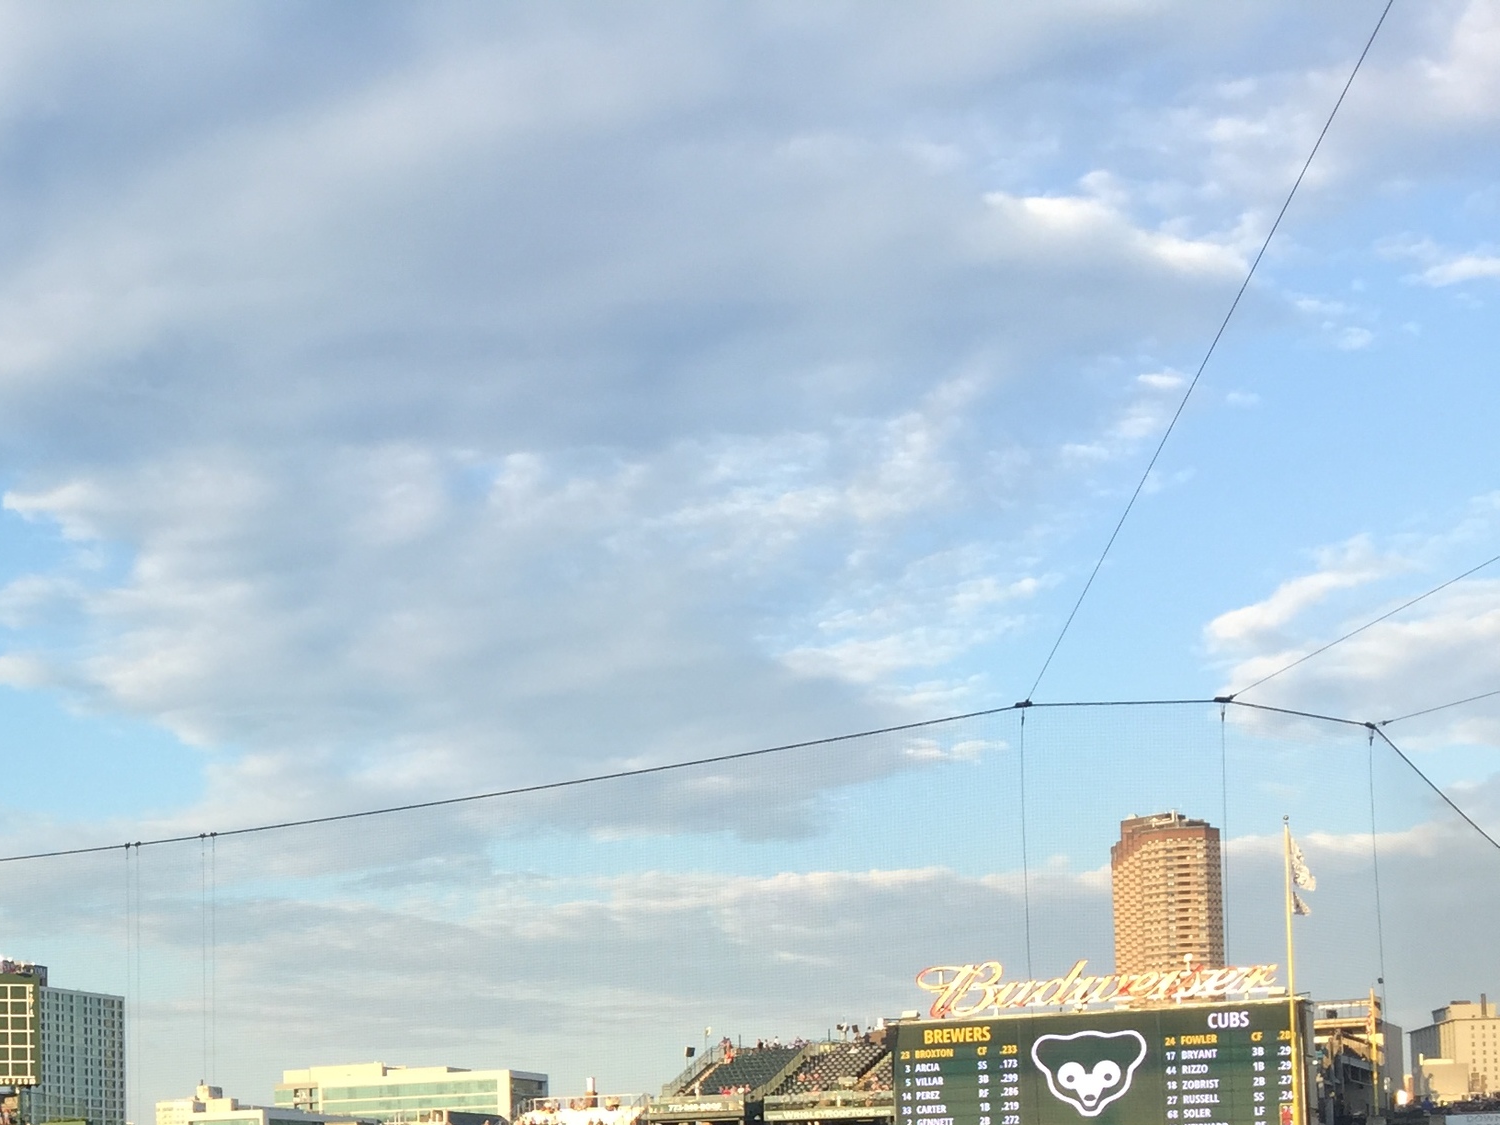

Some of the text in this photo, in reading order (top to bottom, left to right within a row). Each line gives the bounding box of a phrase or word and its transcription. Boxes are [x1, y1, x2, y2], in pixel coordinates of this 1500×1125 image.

[915, 953, 1278, 1018] Budweiser
[1207, 1011, 1249, 1029] CUBS
[924, 1026, 991, 1044] BREWERS
[1164, 1037, 1176, 1046] 24
[1180, 1034, 1218, 1045] FOWLER
[900, 1051, 910, 1060] 23
[915, 1048, 954, 1058] BROXTON
[1000, 1045, 1017, 1054] .233
[1166, 1047, 1264, 1060] 17 BRYANT 3B
[905, 1059, 1018, 1073] 3 ARCIA SS .173
[1166, 1062, 1265, 1075] 44 RIZZO 1B
[916, 1077, 944, 1086] VILLAR
[978, 1074, 990, 1084] 3B
[1167, 1076, 1266, 1090] 18 ZOBRIST 2B
[902, 1092, 912, 1100] 14
[916, 1091, 940, 1100] PEREZ
[1167, 1092, 1265, 1104] 27 RUSSELL SS
[902, 1102, 1020, 1114] 33 CARTER 1B .219
[1168, 1106, 1266, 1118] 68 SOLER LF
[979, 1116, 990, 1125] 2B
[1002, 1115, 1020, 1124] .272
